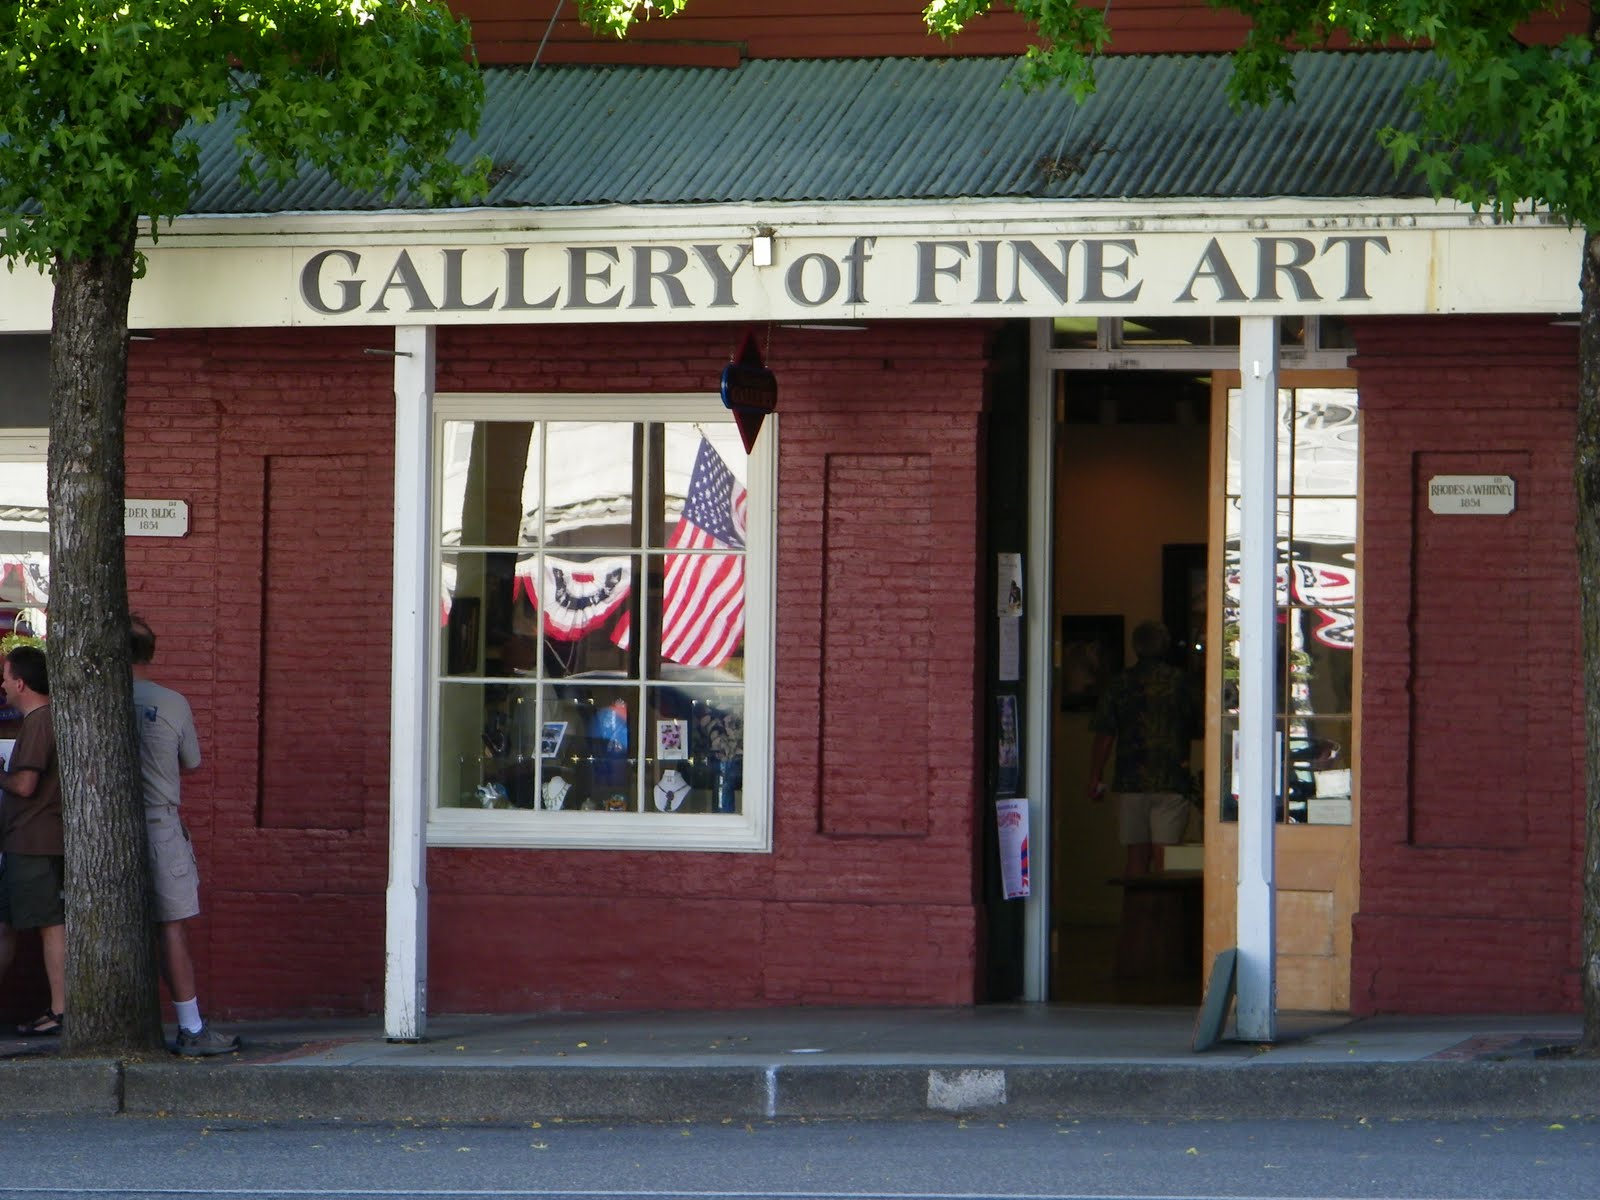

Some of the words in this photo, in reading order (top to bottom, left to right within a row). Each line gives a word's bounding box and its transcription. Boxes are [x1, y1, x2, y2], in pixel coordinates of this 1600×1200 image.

[300, 244, 753, 315] GALLERY
[785, 236, 877, 307] of
[912, 238, 1145, 305] FINE
[1173, 235, 1392, 303] ART
[1431, 484, 1465, 496] RHODES
[1473, 484, 1512, 496] WHITNEY
[151, 508, 176, 519] BLDG
[139, 521, 159, 530] 1854
